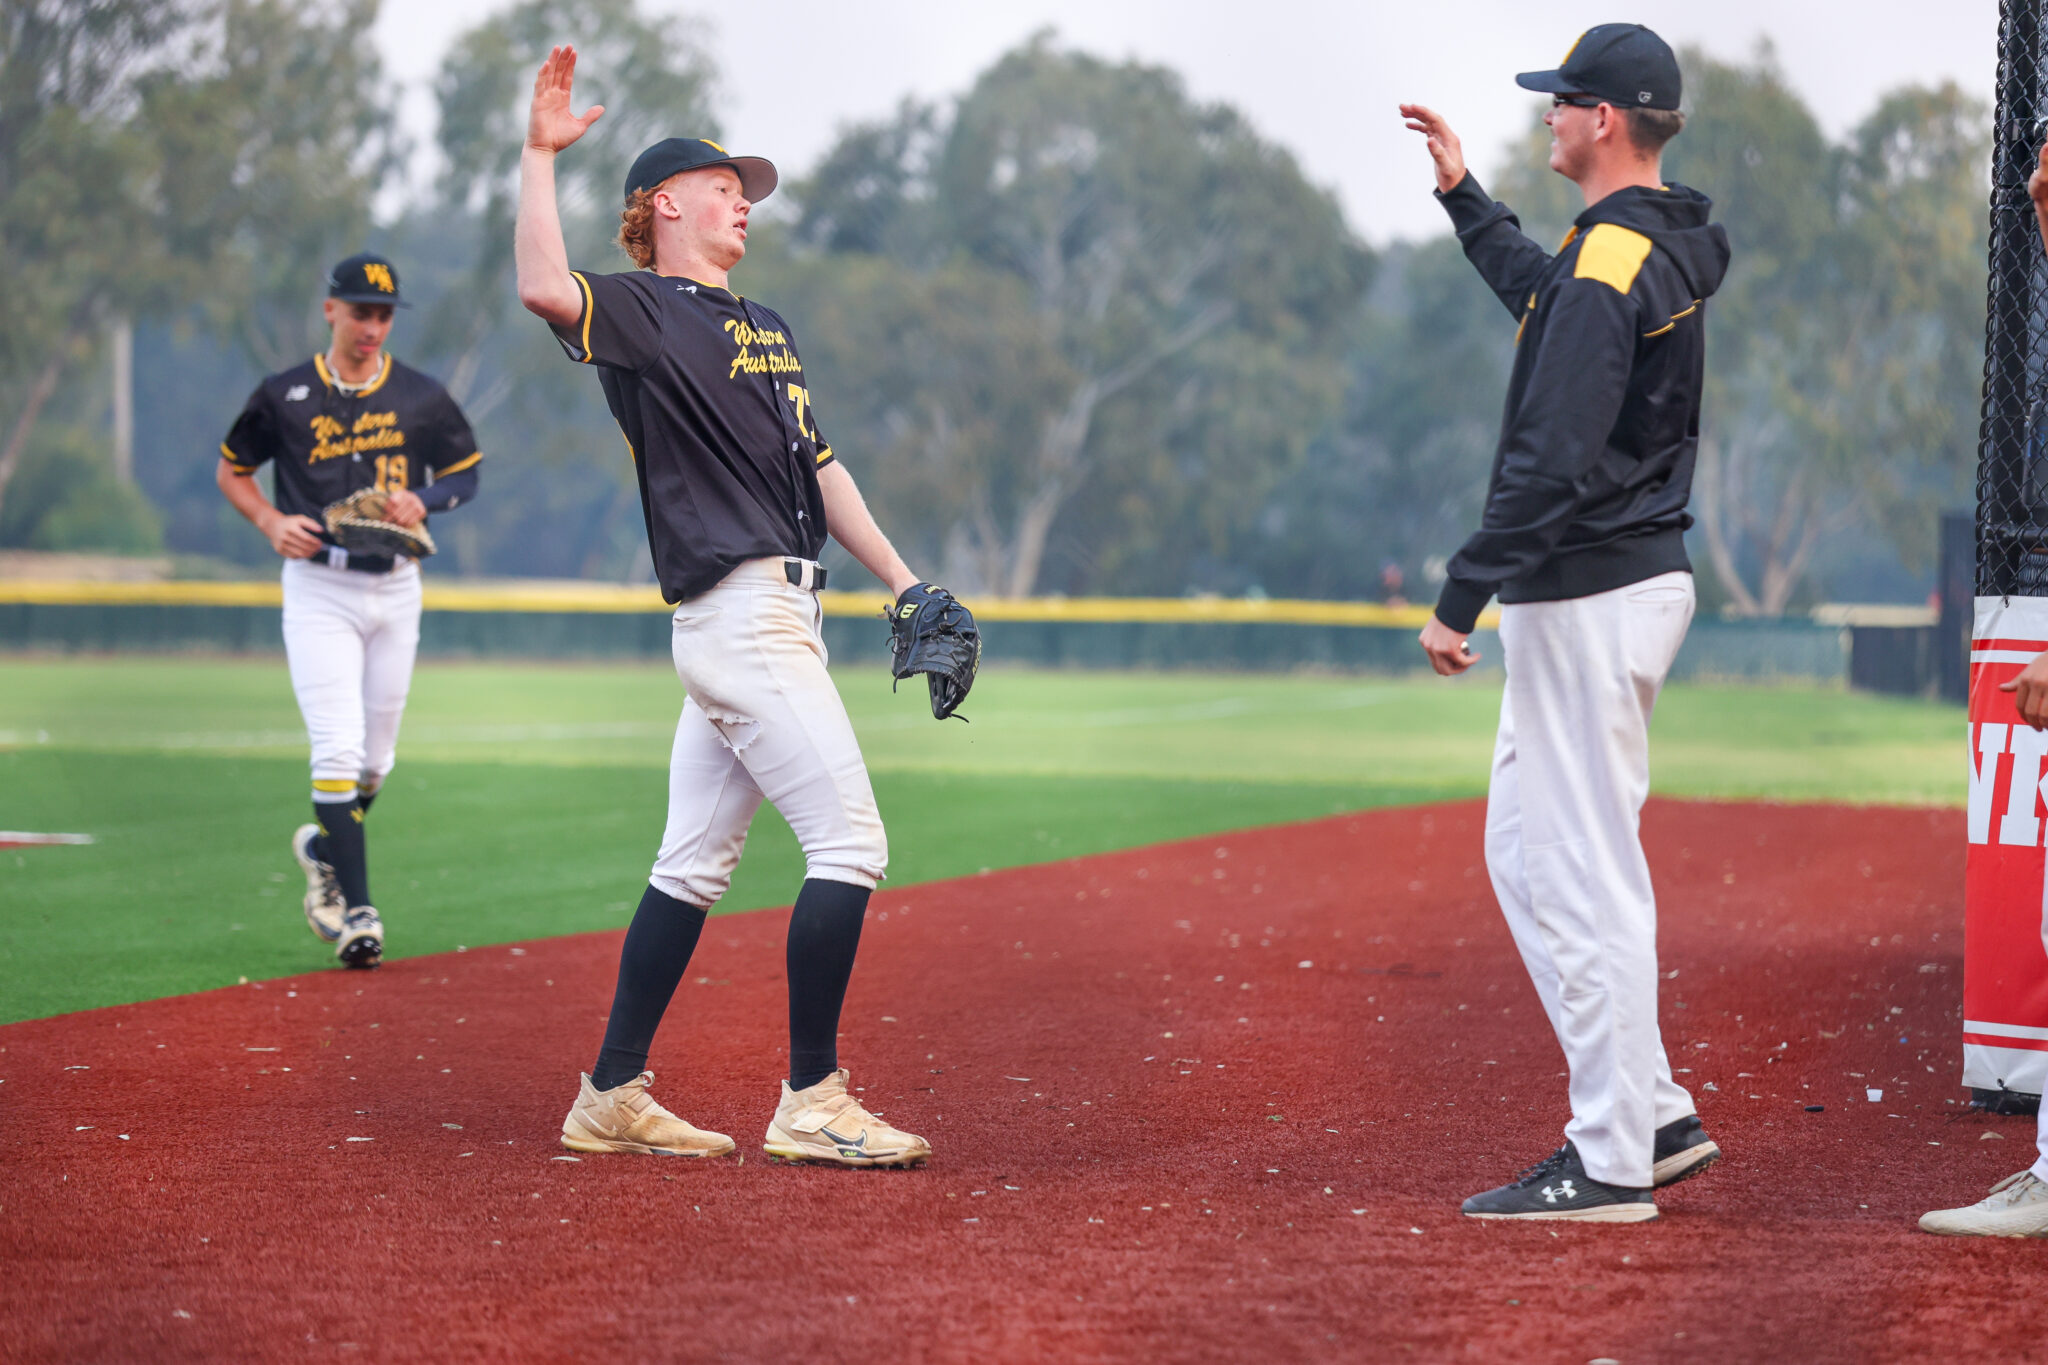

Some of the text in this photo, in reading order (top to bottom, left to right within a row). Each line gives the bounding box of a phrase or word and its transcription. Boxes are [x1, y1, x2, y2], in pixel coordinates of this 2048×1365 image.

[729, 346, 802, 379] Australia
[308, 428, 405, 465] Australia
[373, 454, 408, 495] 19
